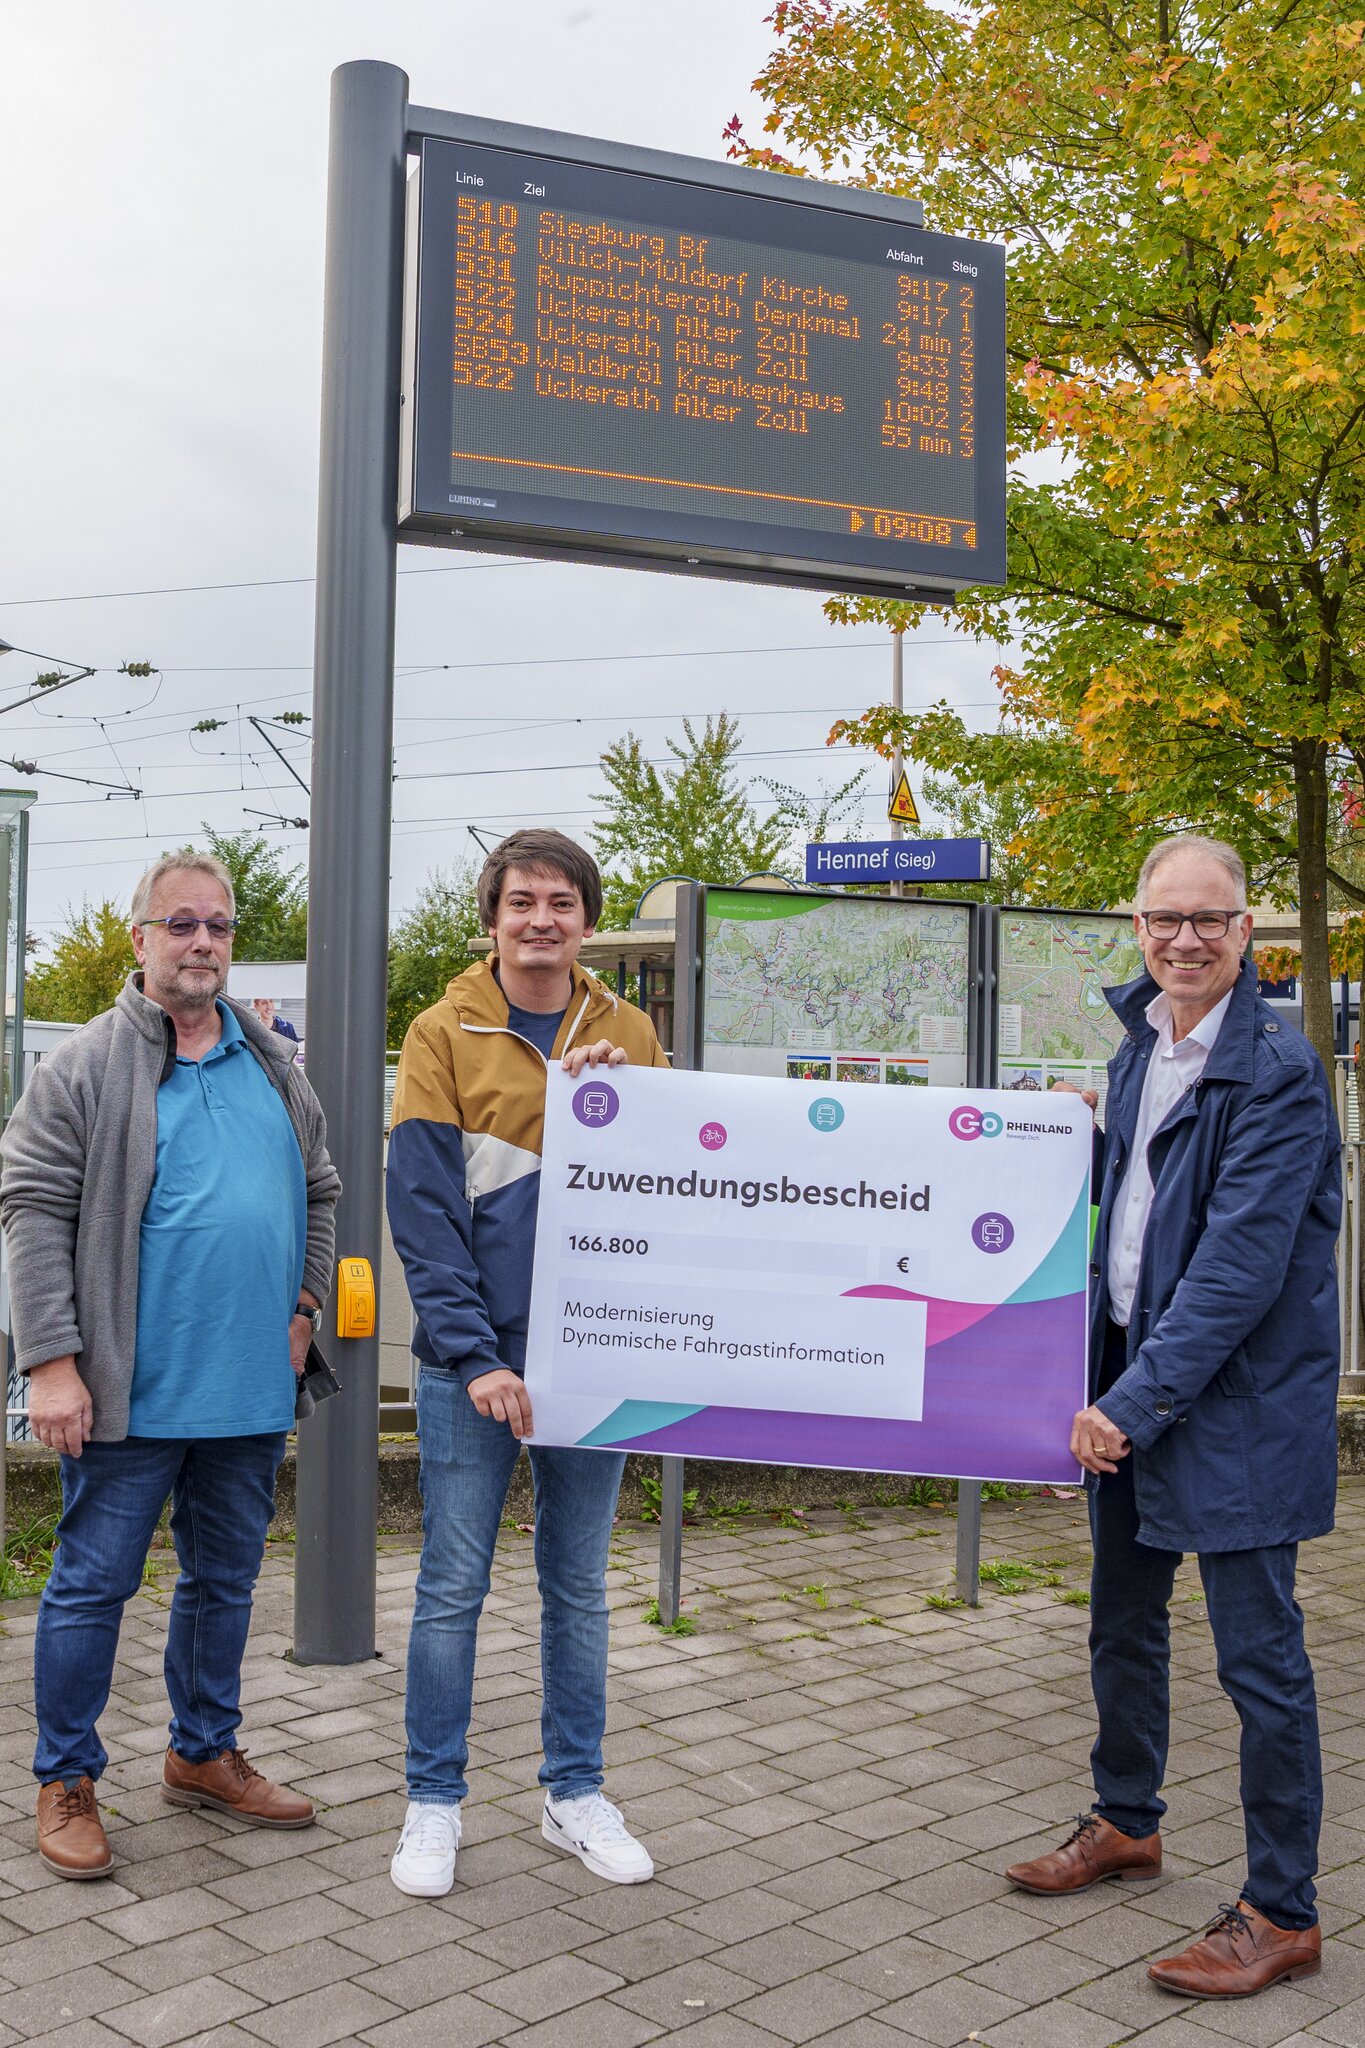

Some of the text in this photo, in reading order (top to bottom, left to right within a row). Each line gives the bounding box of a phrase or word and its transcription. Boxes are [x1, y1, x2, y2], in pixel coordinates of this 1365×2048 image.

[455, 171, 978, 277] Linie Ziel Abfahrt Steig
[457, 197, 975, 309] 510 Siegburg Bf 9:17 2
[456, 224, 972, 332] 516 Vilich-Müldorf Kirche 9:17 1
[456, 251, 975, 358] 531 Ruppichteroth Denkmal 24 min 2
[455, 278, 975, 382] 522 Uckerath Alter Zoll 9:33 3
[455, 305, 975, 407] 524 Uckerath Alter Zoll 9:48 3
[454, 333, 975, 433] SB53 Waldbröl Krankenhaus 10:02 2
[453, 360, 975, 458] 522 Uckerath Alter Zoll 55 min 3
[448, 494, 481, 506] LUMINO
[873, 514, 952, 545] 09:08
[817, 848, 936, 870] Hennef (Sieg)
[1006, 1121, 1073, 1135] RHEINLAND
[1006, 1133, 1027, 1141] Bewegt
[566, 1164, 931, 1212] Zuwendungsbescheid
[568, 1234, 649, 1256] 166.800
[896, 1257, 910, 1273] €
[563, 1301, 714, 1331] Modernisierung
[562, 1327, 885, 1365] Dynamische Fahrgastinformation
